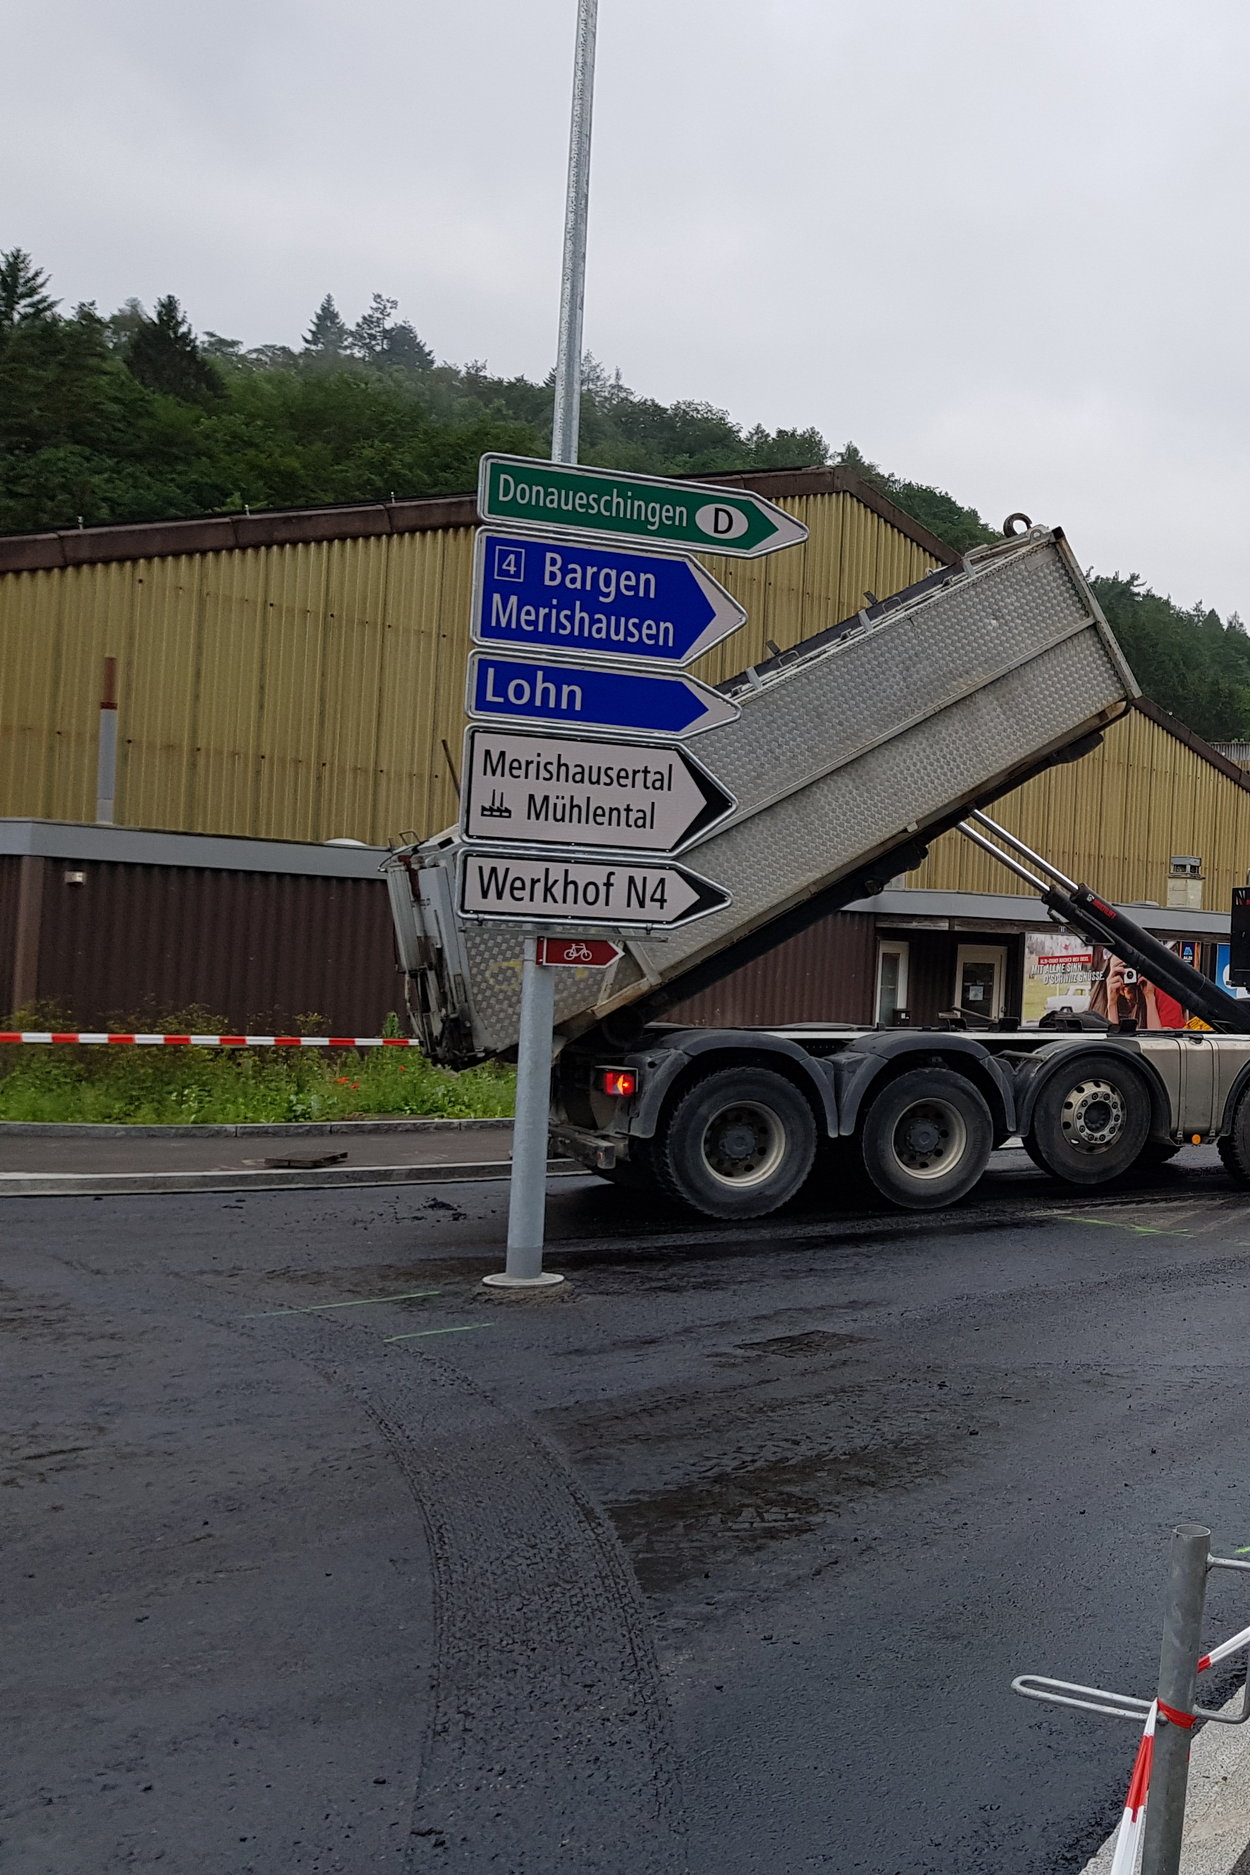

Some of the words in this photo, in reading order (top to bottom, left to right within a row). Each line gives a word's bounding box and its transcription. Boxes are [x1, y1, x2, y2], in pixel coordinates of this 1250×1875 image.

[498, 473, 688, 531] Donaueschingen
[713, 508, 733, 535] D
[502, 553, 517, 575] 4
[543, 552, 656, 602] Bargen
[490, 593, 674, 647] Merishausen
[485, 667, 583, 711] Lohn
[482, 749, 673, 792] Merishausertal
[526, 793, 656, 830] Mühlental
[478, 866, 615, 907] Werkhof
[626, 875, 668, 910] N4
